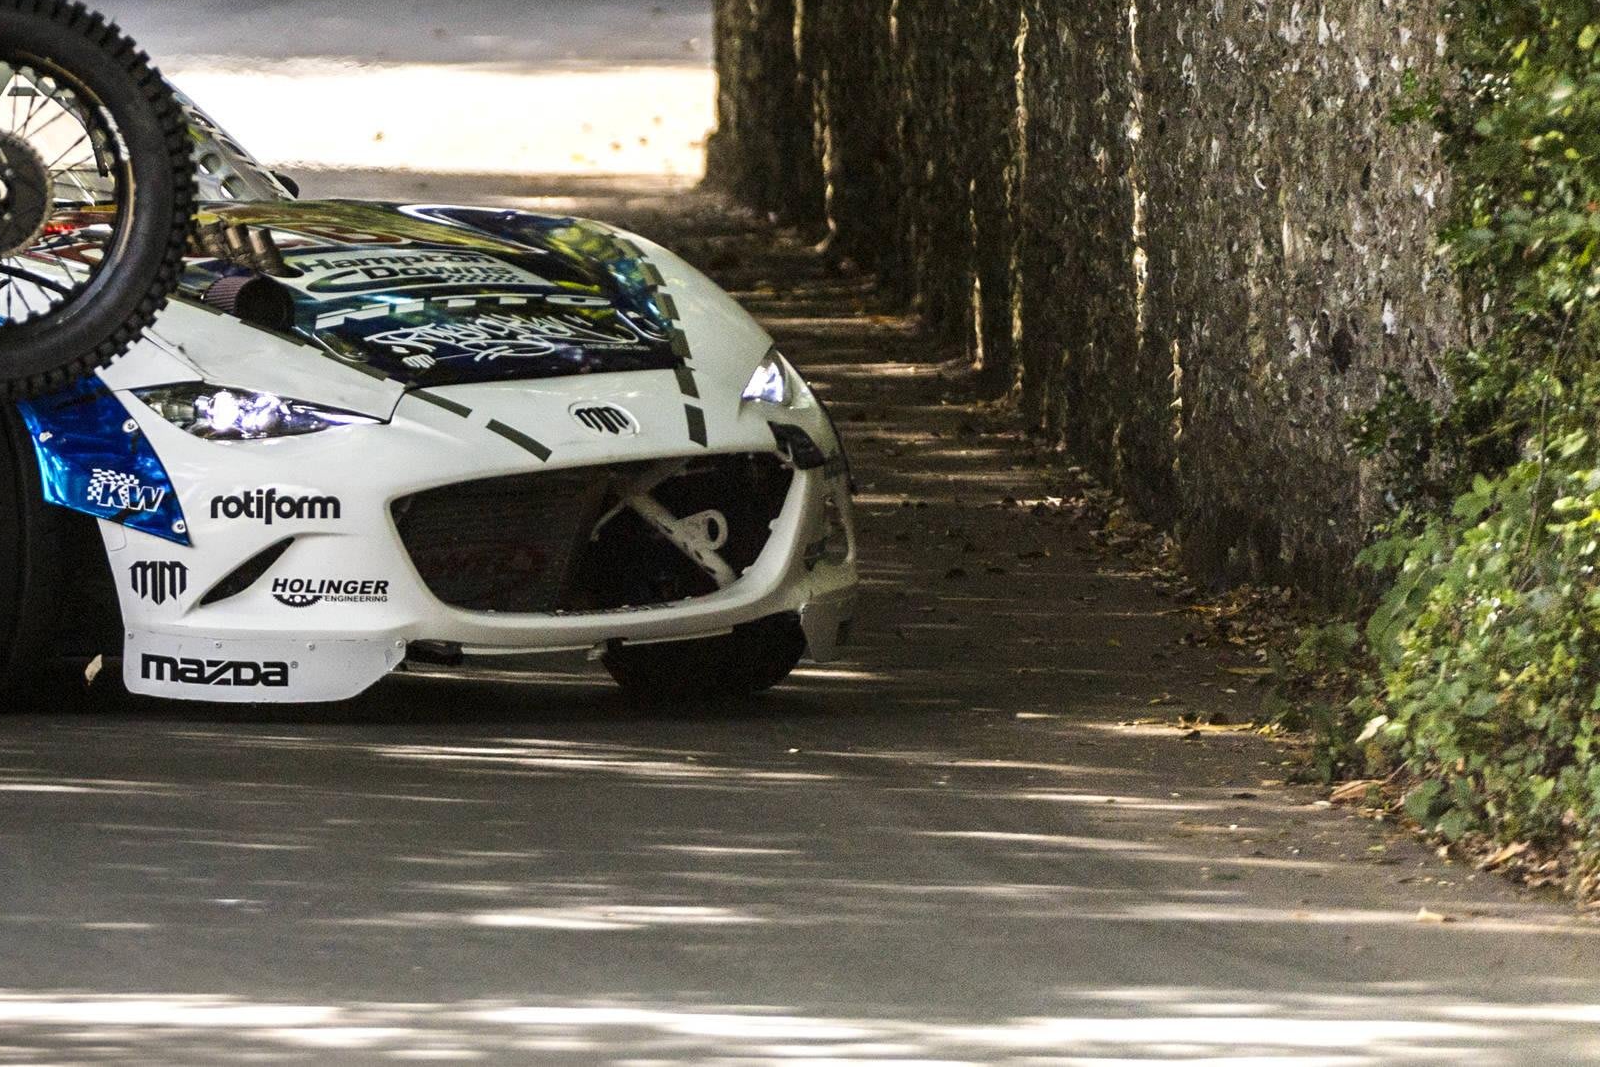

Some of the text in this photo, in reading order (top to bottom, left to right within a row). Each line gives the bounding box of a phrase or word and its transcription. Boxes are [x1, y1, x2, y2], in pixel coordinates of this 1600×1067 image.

[293, 251, 497, 273] Hampton
[360, 262, 513, 280] Downs
[97, 481, 166, 512] KW
[210, 488, 341, 525] rotiform
[272, 577, 389, 594] HOLINGER
[141, 653, 289, 687] mazda
